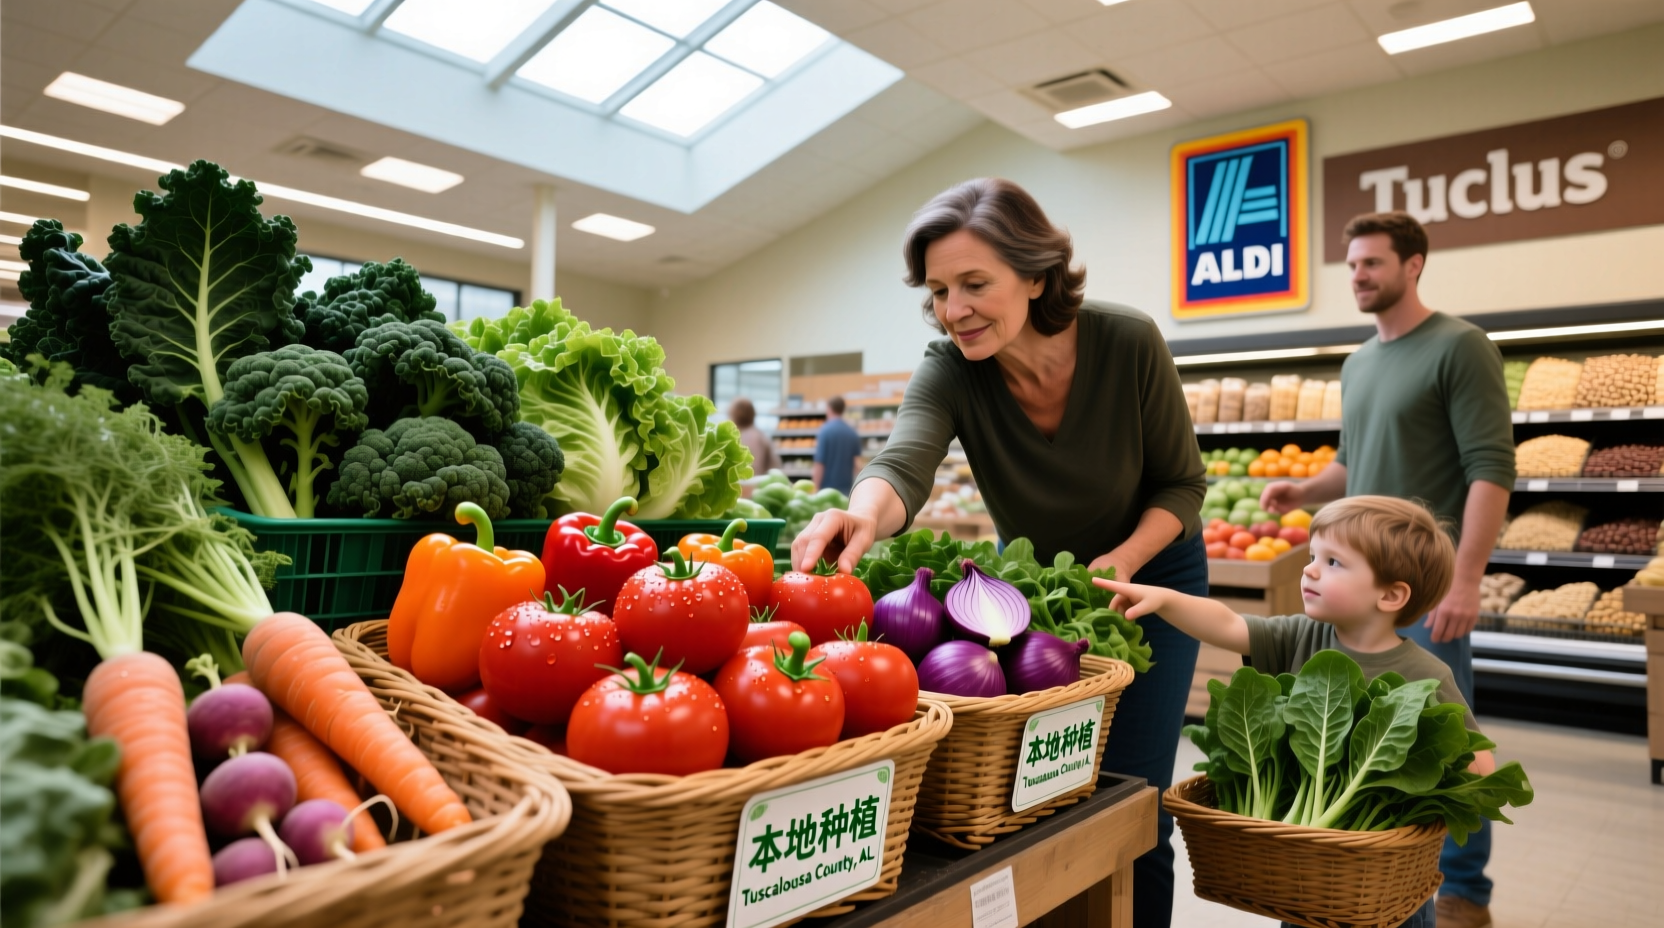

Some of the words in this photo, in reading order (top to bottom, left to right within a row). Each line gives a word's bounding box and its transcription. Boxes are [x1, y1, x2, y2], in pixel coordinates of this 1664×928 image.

[1359, 148, 1608, 225] Tuclus
[1191, 243, 1284, 286] ALDI
[1026, 718, 1096, 768] 本地种植
[748, 794, 880, 874] 本地种植
[742, 871, 812, 907] Tuscalousa
[859, 845, 875, 863] AL
